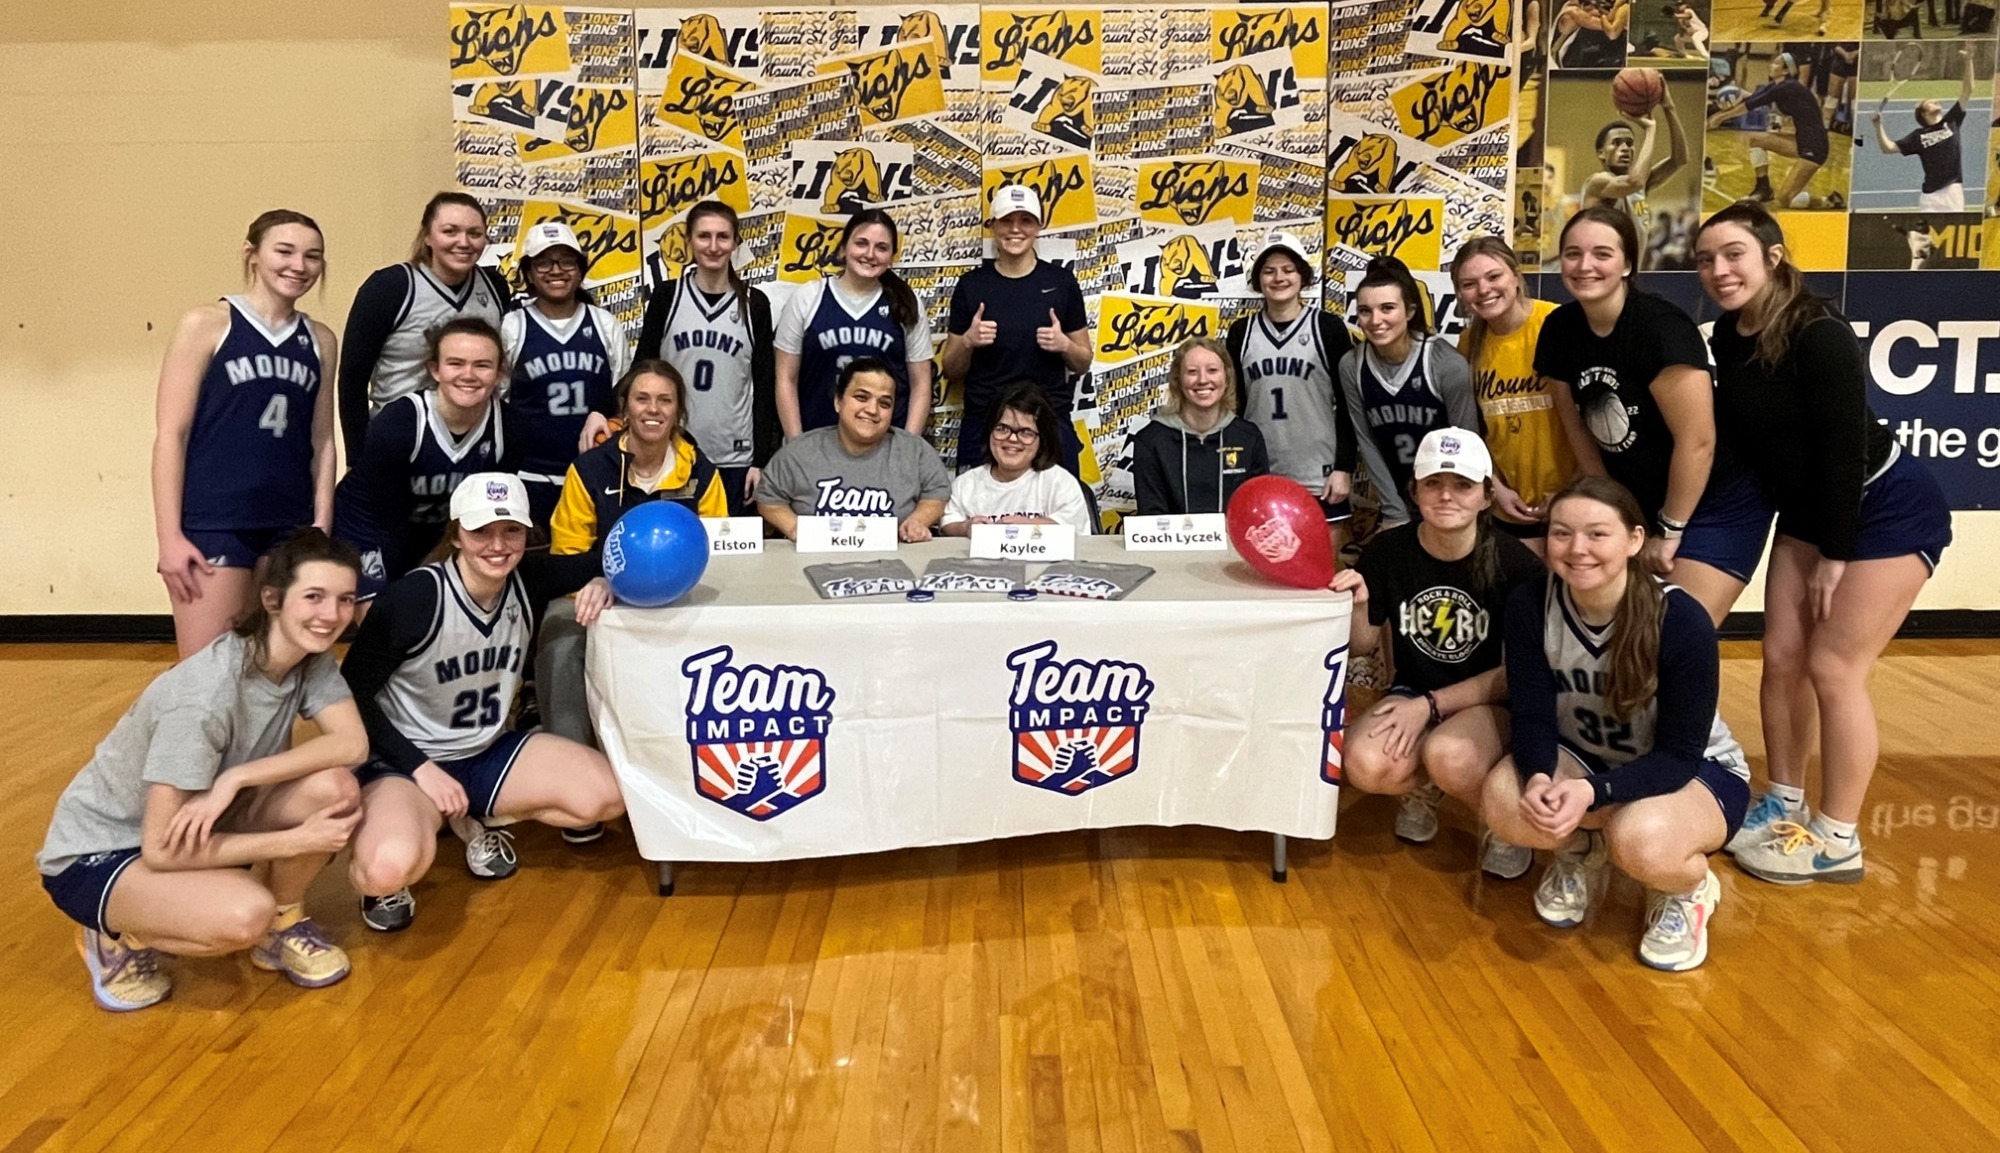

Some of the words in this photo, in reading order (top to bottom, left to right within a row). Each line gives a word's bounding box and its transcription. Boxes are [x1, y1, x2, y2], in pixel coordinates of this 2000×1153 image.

[1332, 5, 1369, 19] LIONS
[580, 24, 618, 35] LIONS
[1368, 21, 1405, 35] LIONS
[451, 11, 557, 69] Lions
[760, 31, 805, 45] Mount
[986, 20, 1094, 71] Lions
[1102, 29, 1136, 43] ount
[1160, 27, 1211, 49] Joseph
[1213, 17, 1320, 63] Lions
[1332, 37, 1368, 51] LIONS
[582, 56, 620, 66] LIONS
[1102, 61, 1136, 76] ount
[1367, 53, 1404, 67] LIONS
[761, 63, 806, 77] Mount
[735, 94, 770, 111] LIONS
[807, 88, 841, 105] LIONS
[1093, 91, 1129, 103] LIONS
[1164, 96, 1200, 108] LIONS
[775, 106, 809, 122] LIONS
[1129, 109, 1165, 121] LIONS
[742, 124, 777, 140] LIONS
[814, 119, 848, 135] LIONS
[1094, 122, 1130, 134] LIONS
[1166, 127, 1202, 139] LIONS
[455, 140, 503, 156] Mount
[983, 140, 1029, 155] Mount
[1131, 140, 1167, 152] LIONS
[586, 158, 623, 168] LIONS
[1466, 155, 1508, 167] LIONS
[455, 172, 503, 188] Mount
[1288, 171, 1324, 188] LIONS
[1466, 166, 1506, 178] LIONS
[588, 189, 624, 199] LIONS
[641, 160, 738, 217] Lions
[1140, 169, 1248, 210] Lions
[1280, 201, 1316, 218] LIONS
[1335, 208, 1434, 250] Lions
[1096, 231, 1130, 245] LIONS
[1332, 247, 1368, 269] LIONS
[741, 266, 775, 280] LIONS
[601, 289, 635, 306] LIONS
[818, 327, 894, 352] MOUNT
[1101, 312, 1208, 352] Lions
[674, 329, 743, 357] MOUNT
[224, 354, 318, 392] MOUNT
[524, 351, 604, 380] MOUNT
[1139, 362, 1172, 381] LIONS
[1248, 356, 1316, 381] MOUNT
[694, 359, 714, 392] 0
[1476, 369, 1548, 399] Mount
[547, 380, 589, 416] 21
[1108, 383, 1142, 400] LIONS
[1271, 387, 1288, 420] 1
[259, 393, 288, 438] 4
[1366, 404, 1439, 426] MOUNT
[1895, 418, 1967, 458] the
[816, 478, 892, 511] Team
[713, 540, 756, 551] Elston
[831, 536, 865, 548] Kelly
[1132, 532, 1172, 543] Coach
[1176, 531, 1222, 545] Lyczek
[1000, 543, 1046, 555] Kaylee
[1416, 590, 1442, 604] ROCK
[1451, 592, 1473, 610] ROLL
[435, 645, 521, 684] MOUNT
[685, 648, 832, 716] Team
[1010, 644, 1151, 706] Team
[451, 682, 500, 729] 25
[1014, 705, 1145, 728] IMPACT
[691, 714, 829, 740] IMPACT
[1573, 706, 1637, 756] 32
